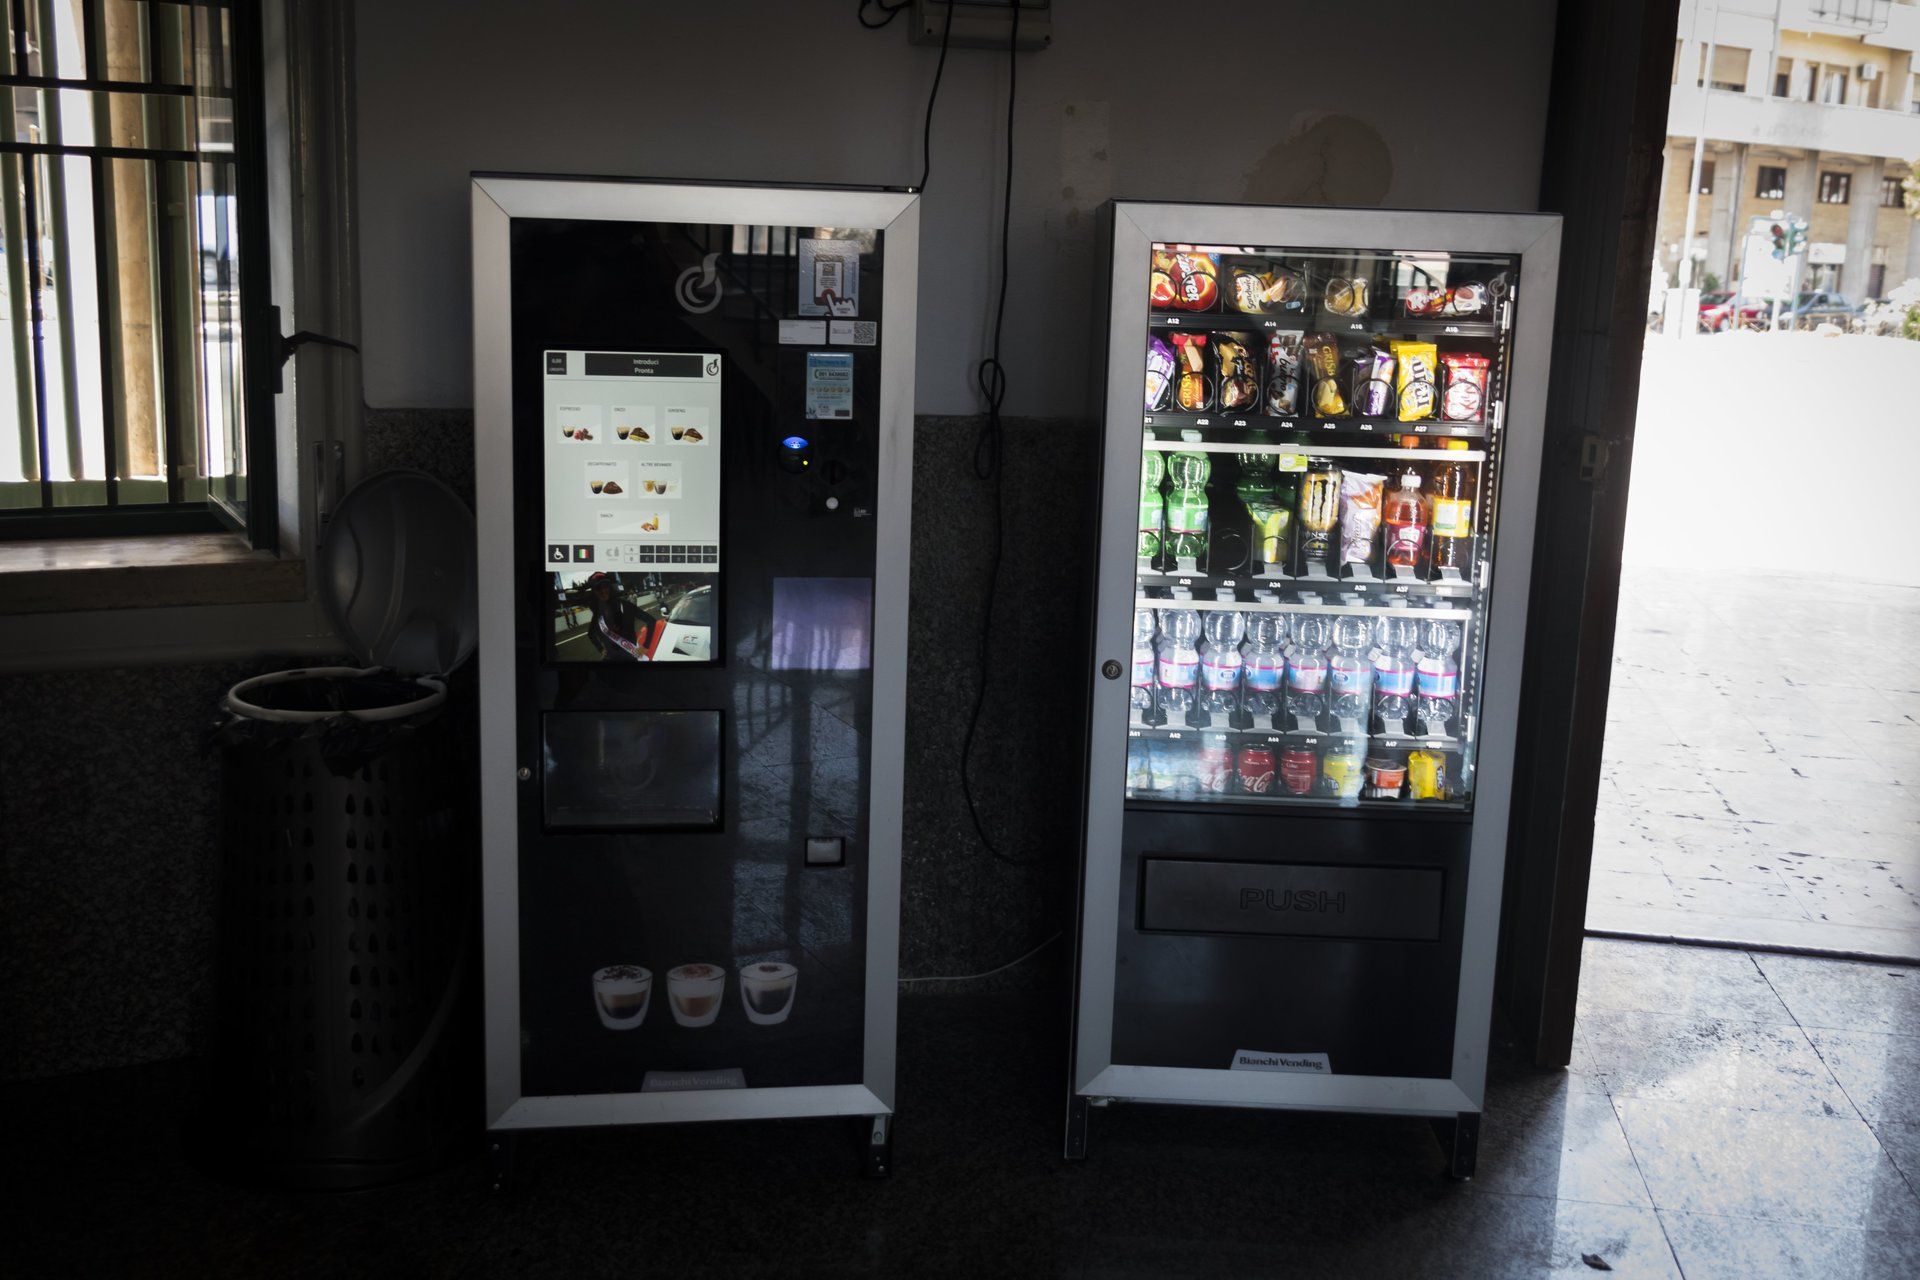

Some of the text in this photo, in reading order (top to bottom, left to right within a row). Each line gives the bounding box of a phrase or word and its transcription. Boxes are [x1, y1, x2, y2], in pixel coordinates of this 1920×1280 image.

[1240, 887, 1345, 913] PUSH
[1240, 1056, 1322, 1070] Bianchi Vending
